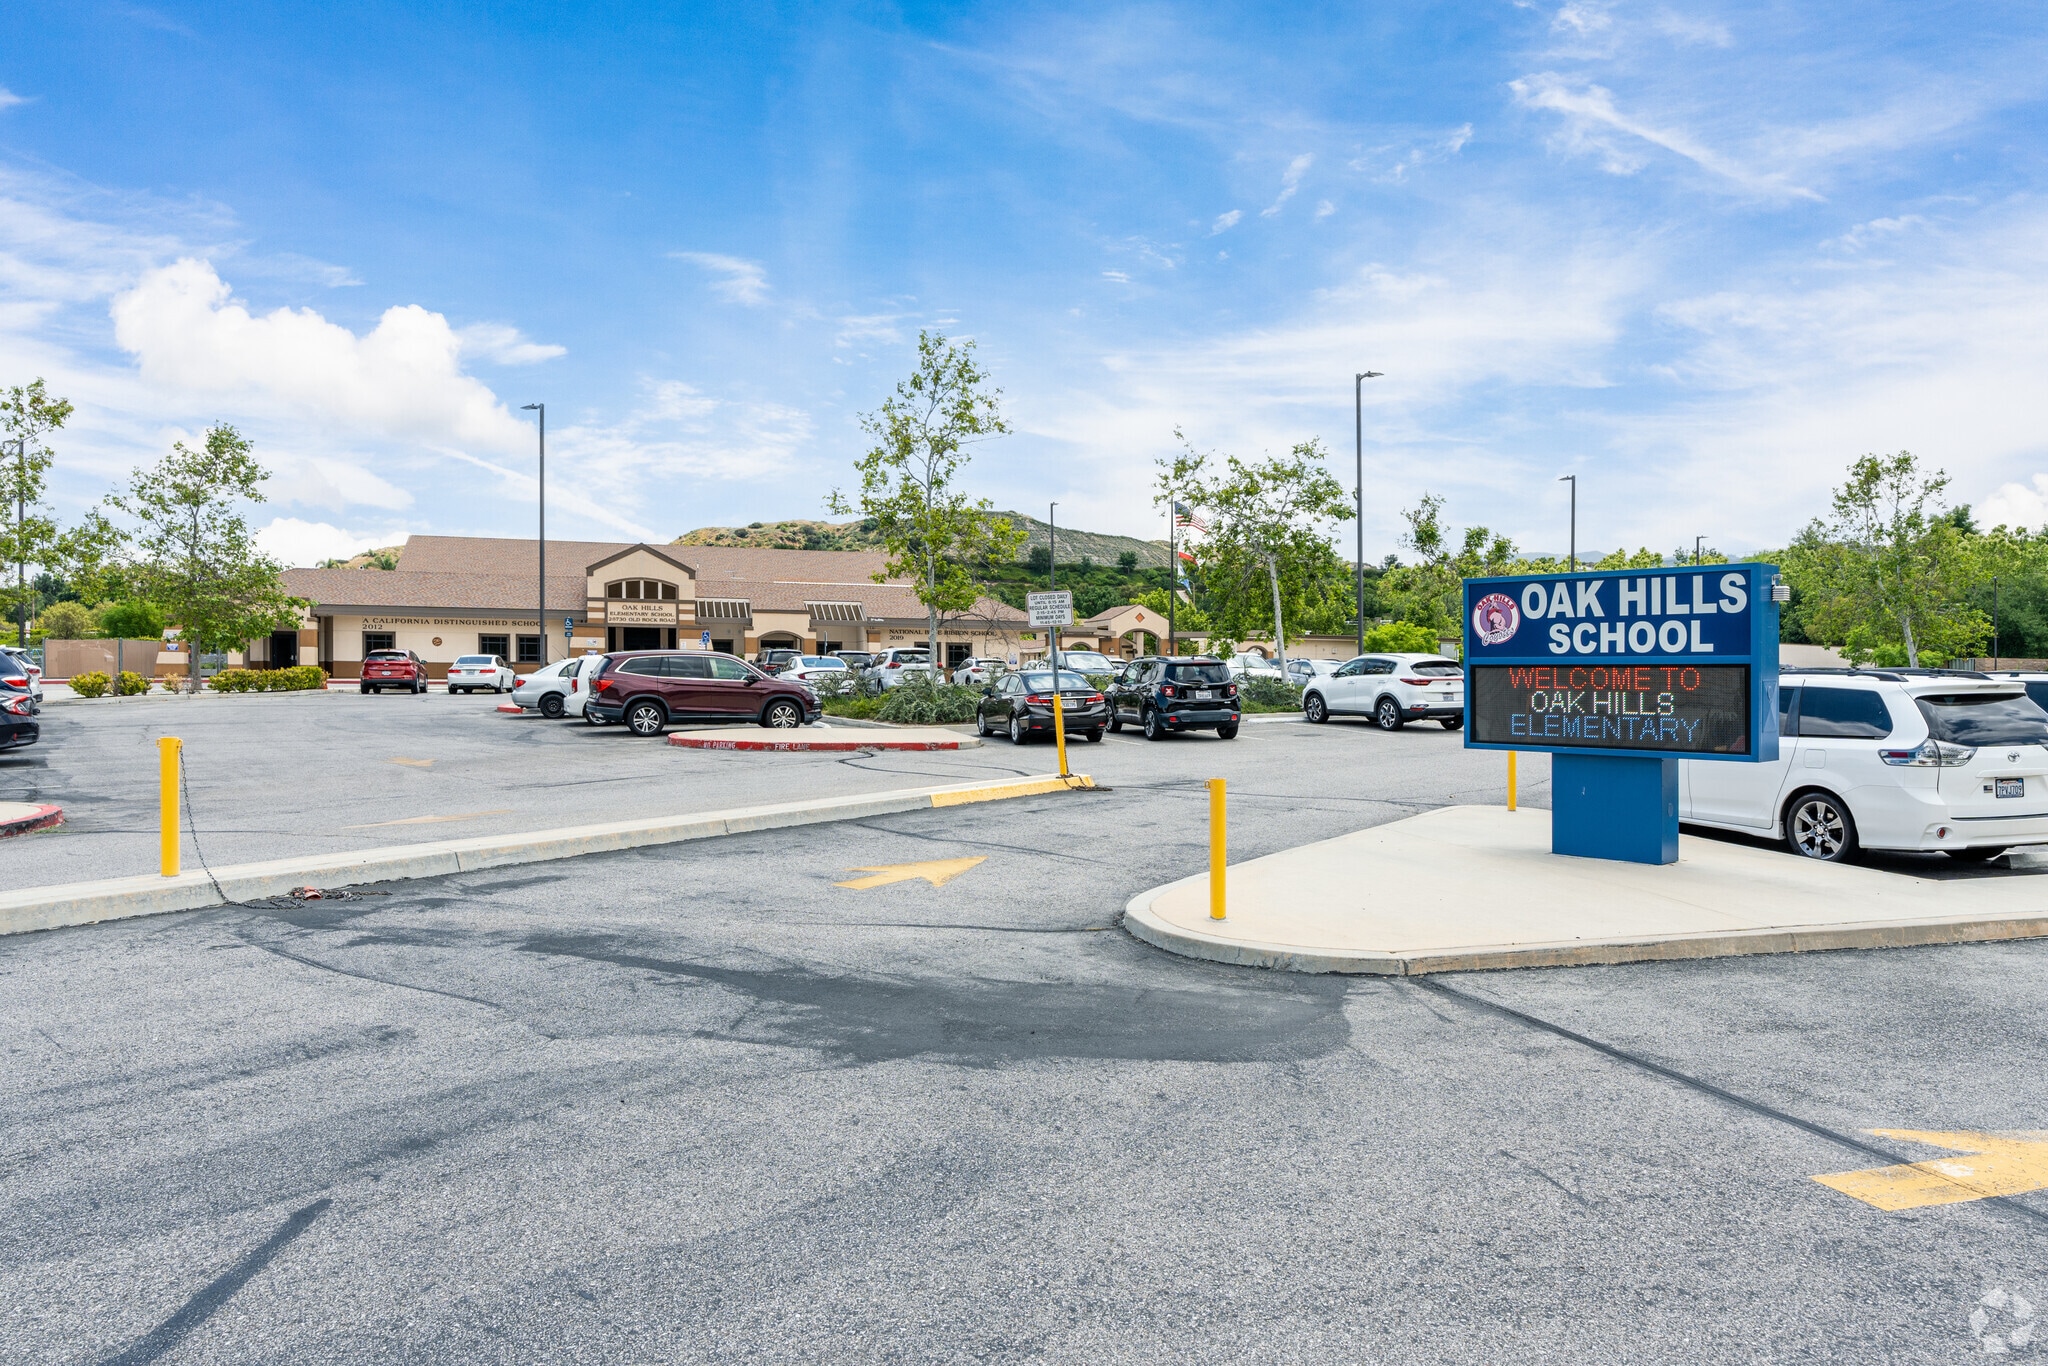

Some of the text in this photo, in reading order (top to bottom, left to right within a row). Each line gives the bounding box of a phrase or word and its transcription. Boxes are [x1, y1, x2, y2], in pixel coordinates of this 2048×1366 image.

[1477, 595, 1515, 611] OAK HILLS
[1521, 573, 1747, 619] OAK HILLS
[1549, 620, 1714, 654] SCHOOL
[1509, 667, 1701, 691] WELCOME TO
[1531, 690, 1675, 716] OAK HILLS
[1511, 713, 1700, 742] ELEMENTARY
[712, 741, 736, 749] PARKING
